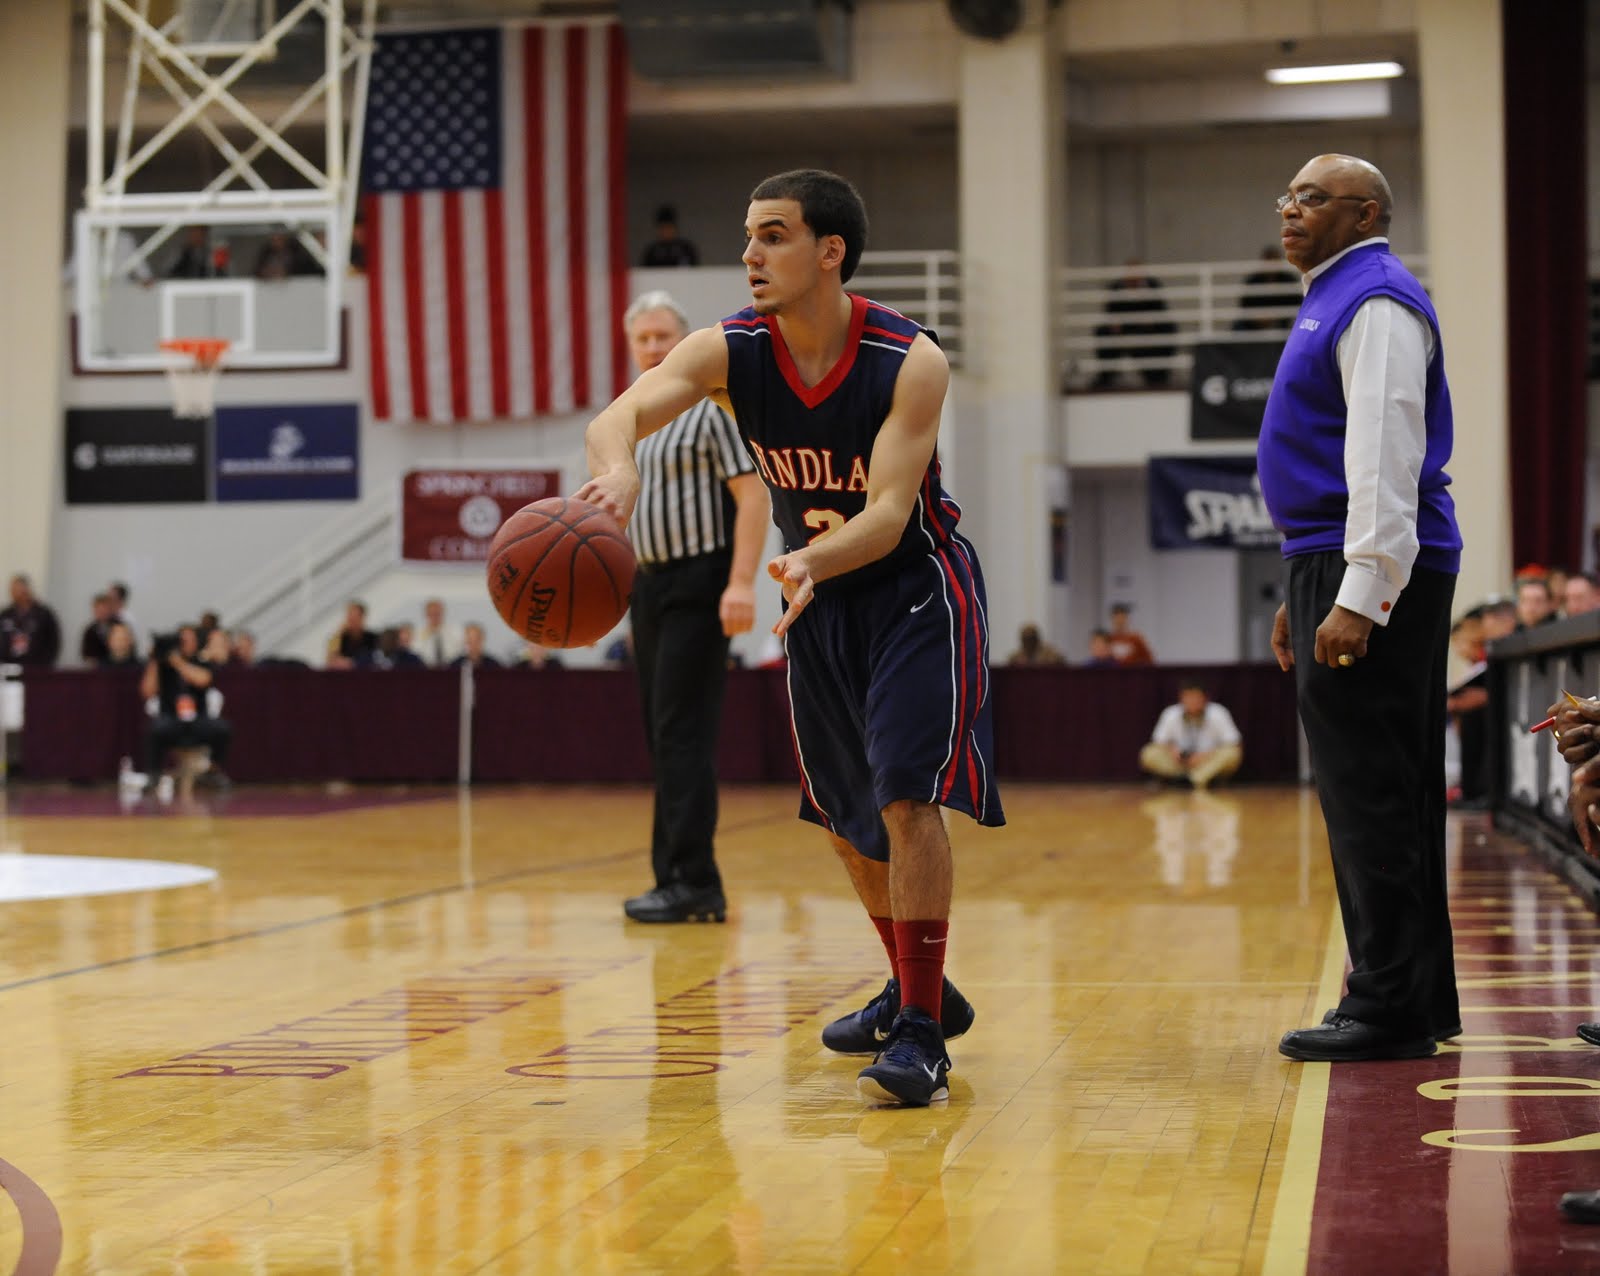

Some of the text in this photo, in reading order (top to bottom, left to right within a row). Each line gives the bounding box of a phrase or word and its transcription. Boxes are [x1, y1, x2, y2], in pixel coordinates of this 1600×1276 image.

[749, 438, 869, 491] FINDLA
[1184, 489, 1274, 541] SPAL
[429, 536, 490, 560] COLL
[526, 582, 557, 642] SPALDI
